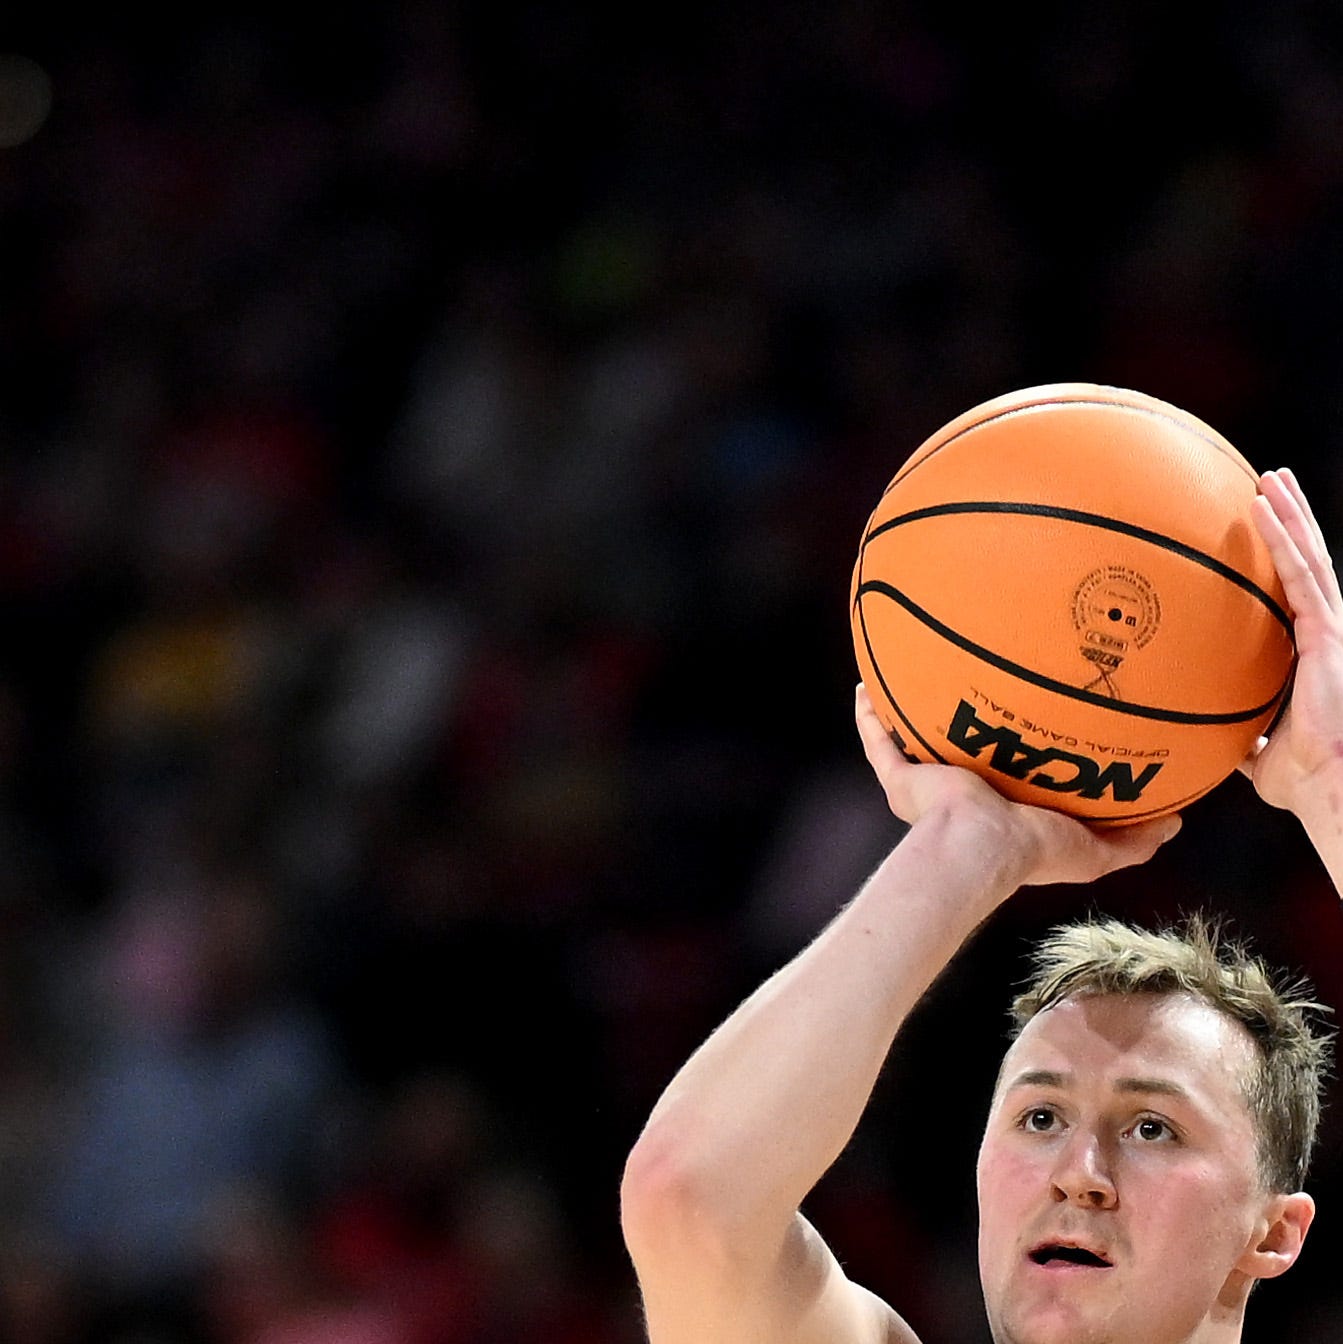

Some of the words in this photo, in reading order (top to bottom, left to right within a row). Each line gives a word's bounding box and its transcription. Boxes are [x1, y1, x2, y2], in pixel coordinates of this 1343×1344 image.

[969, 684, 1016, 722] BALL
[1019, 717, 1078, 748] GAME
[1084, 739, 1170, 759] OFFICIAL
[946, 698, 1165, 803] NCAA
